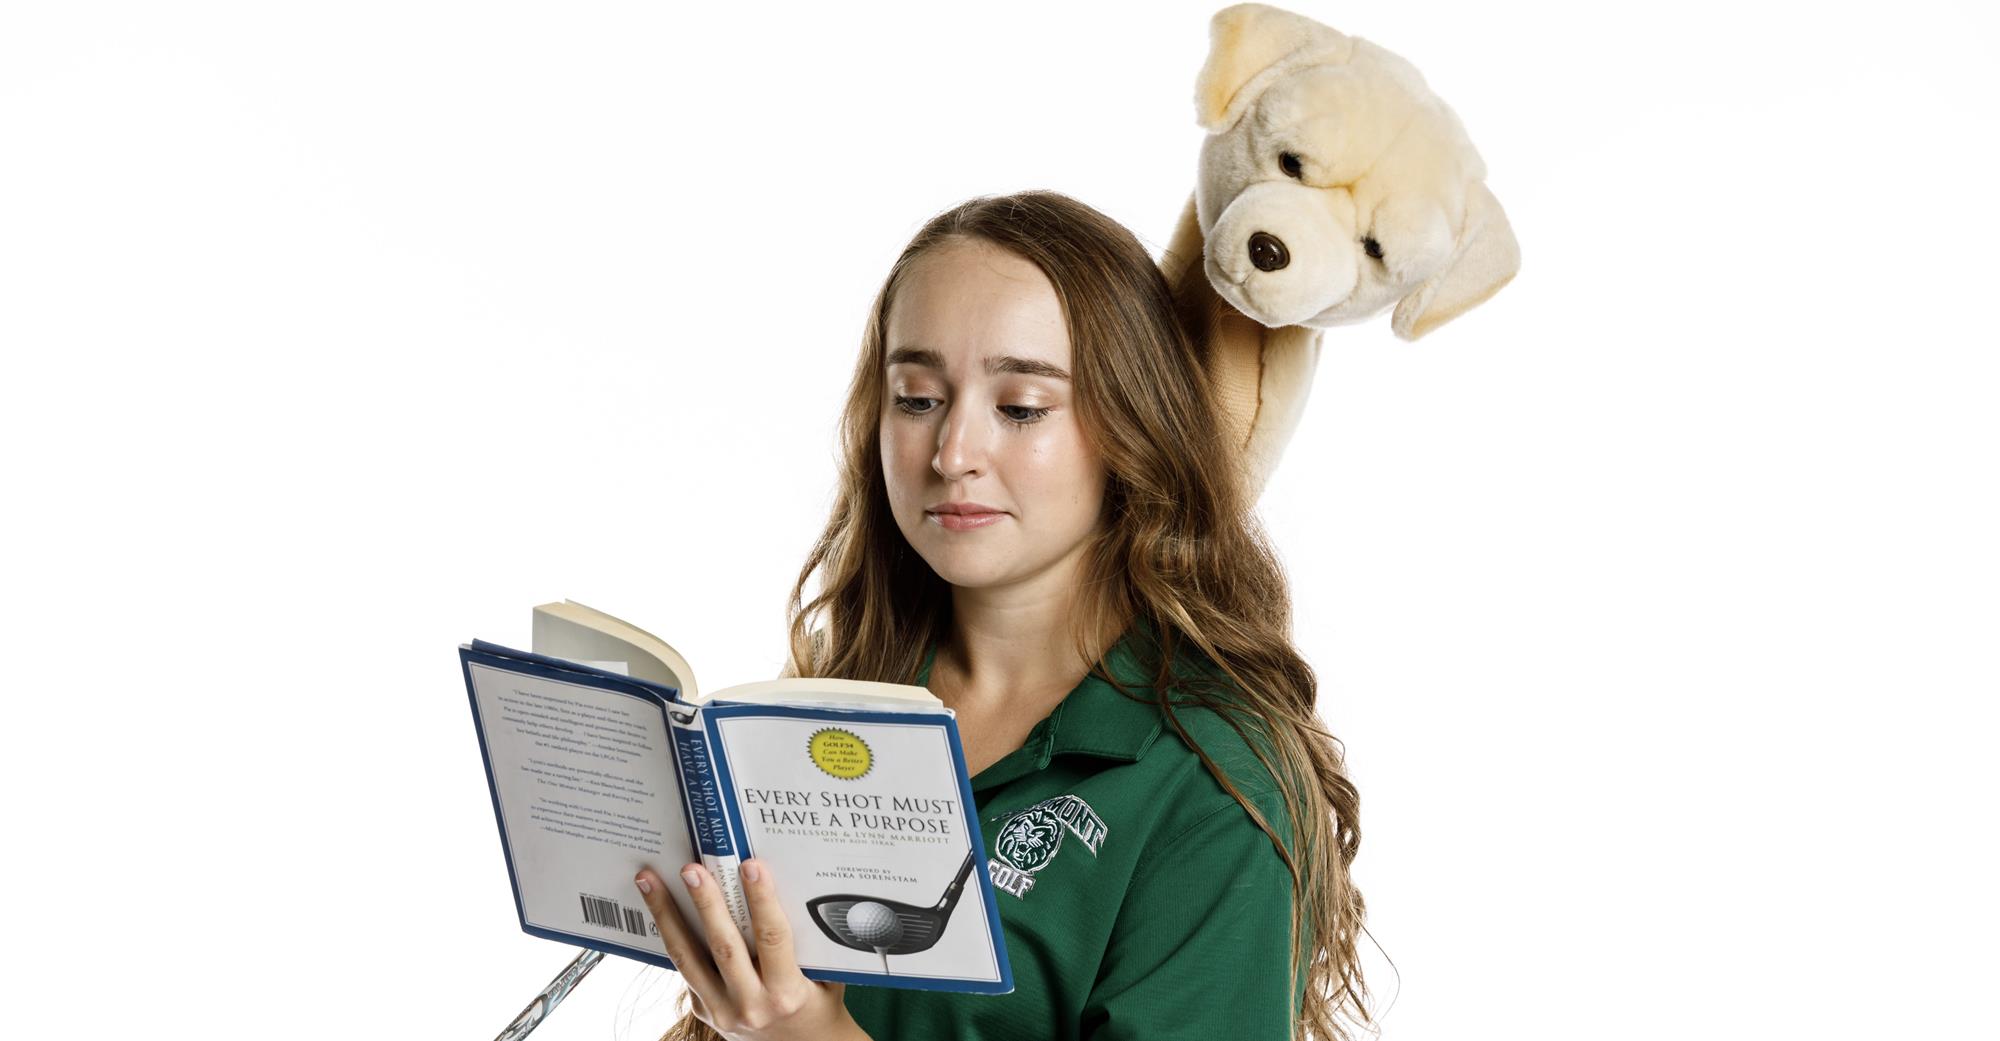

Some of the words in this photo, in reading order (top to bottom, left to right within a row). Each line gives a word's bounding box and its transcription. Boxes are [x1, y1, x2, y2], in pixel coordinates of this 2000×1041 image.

[680, 742, 696, 774] HAVE
[691, 791, 712, 845] PURPOSE
[690, 739, 709, 776] EVERY
[700, 780, 718, 813] SHOT
[710, 818, 728, 850] MUST
[744, 788, 812, 806] EVERY
[820, 791, 882, 810] SHOT
[892, 796, 955, 814] MUST
[759, 808, 821, 826] HAVE
[829, 812, 843, 827] A
[849, 812, 951, 834] PURPOSE
[788, 828, 838, 837] NILSSON
[856, 832, 885, 840] LYNN
[890, 834, 950, 844] MARRIOTT
[836, 866, 880, 874] FOREWORD
[859, 874, 918, 884] SORENSTAM
